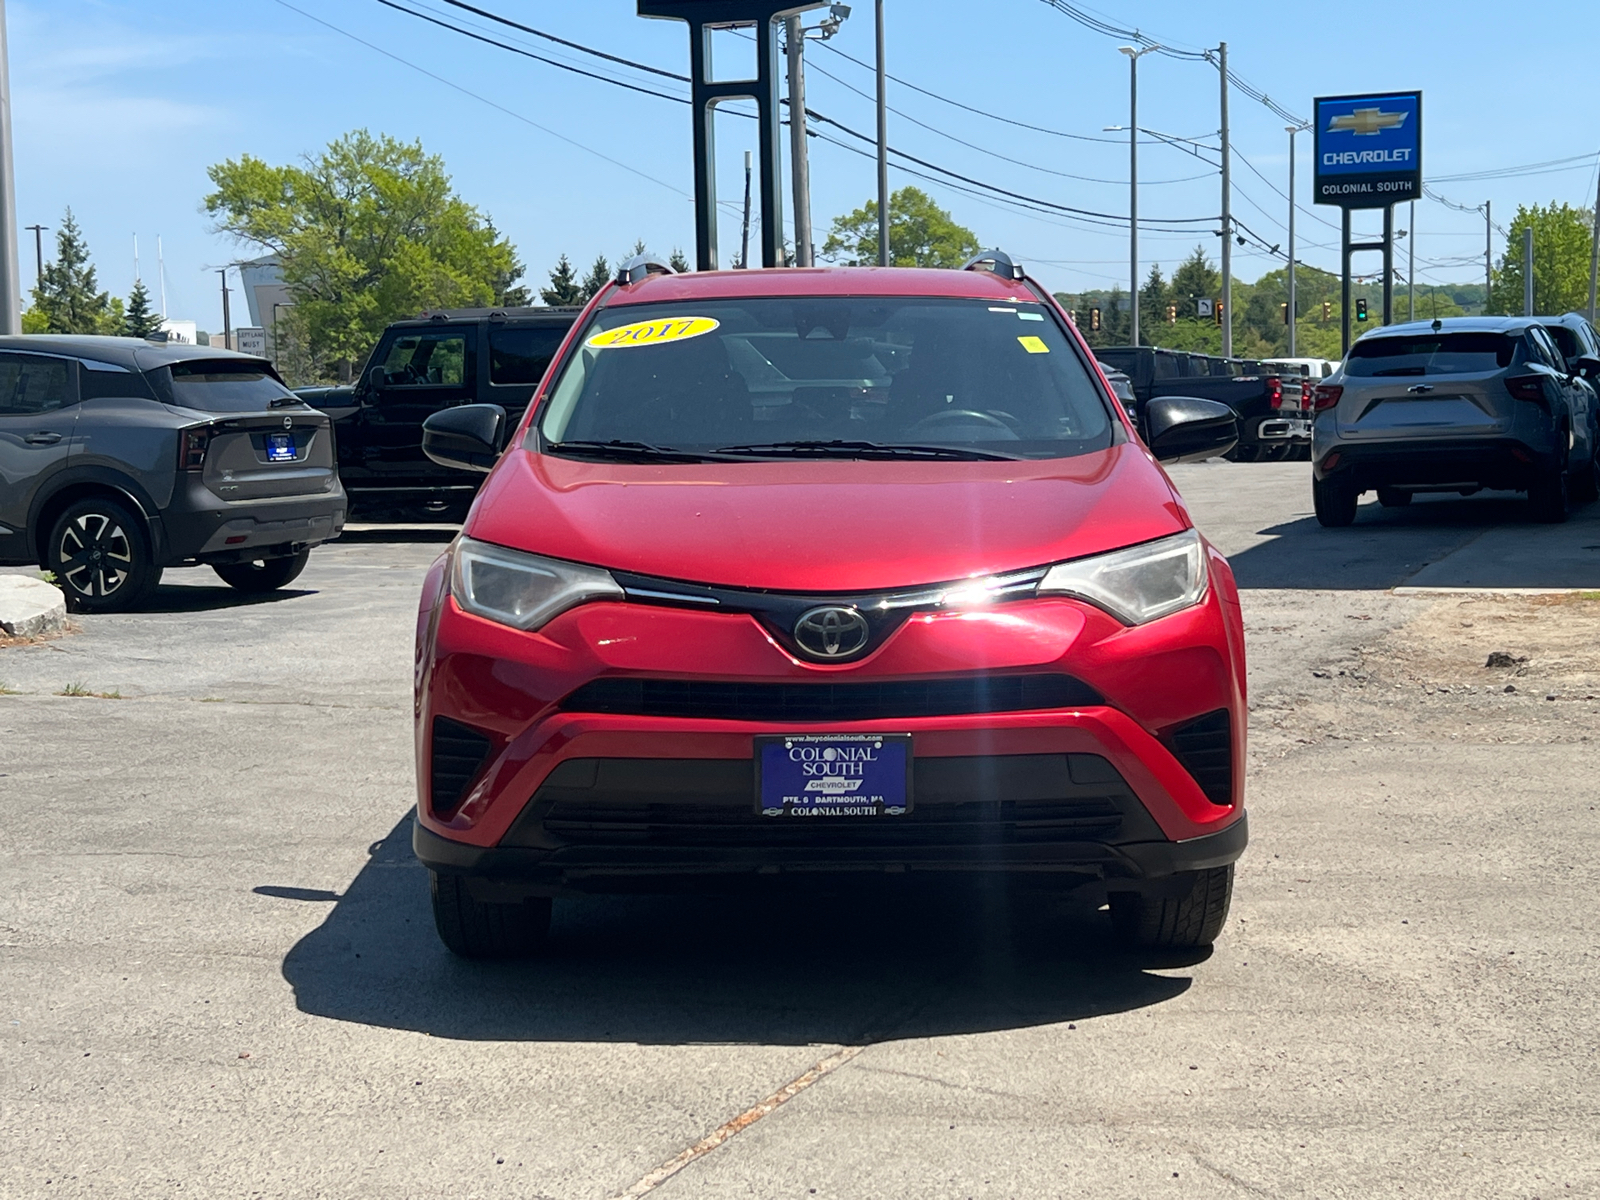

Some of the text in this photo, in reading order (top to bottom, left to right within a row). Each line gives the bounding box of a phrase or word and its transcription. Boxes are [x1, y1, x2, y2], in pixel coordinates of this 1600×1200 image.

[1323, 148, 1412, 165] CHEVROLET
[1322, 181, 1412, 195] COLONIAL SOUTH
[609, 320, 695, 344] 2017
[789, 747, 878, 762] COLONIAL
[803, 762, 864, 776] SOUTH
[815, 796, 869, 804] DARTMOUTH,
[791, 806, 877, 816] COLONIAL SOUTH
